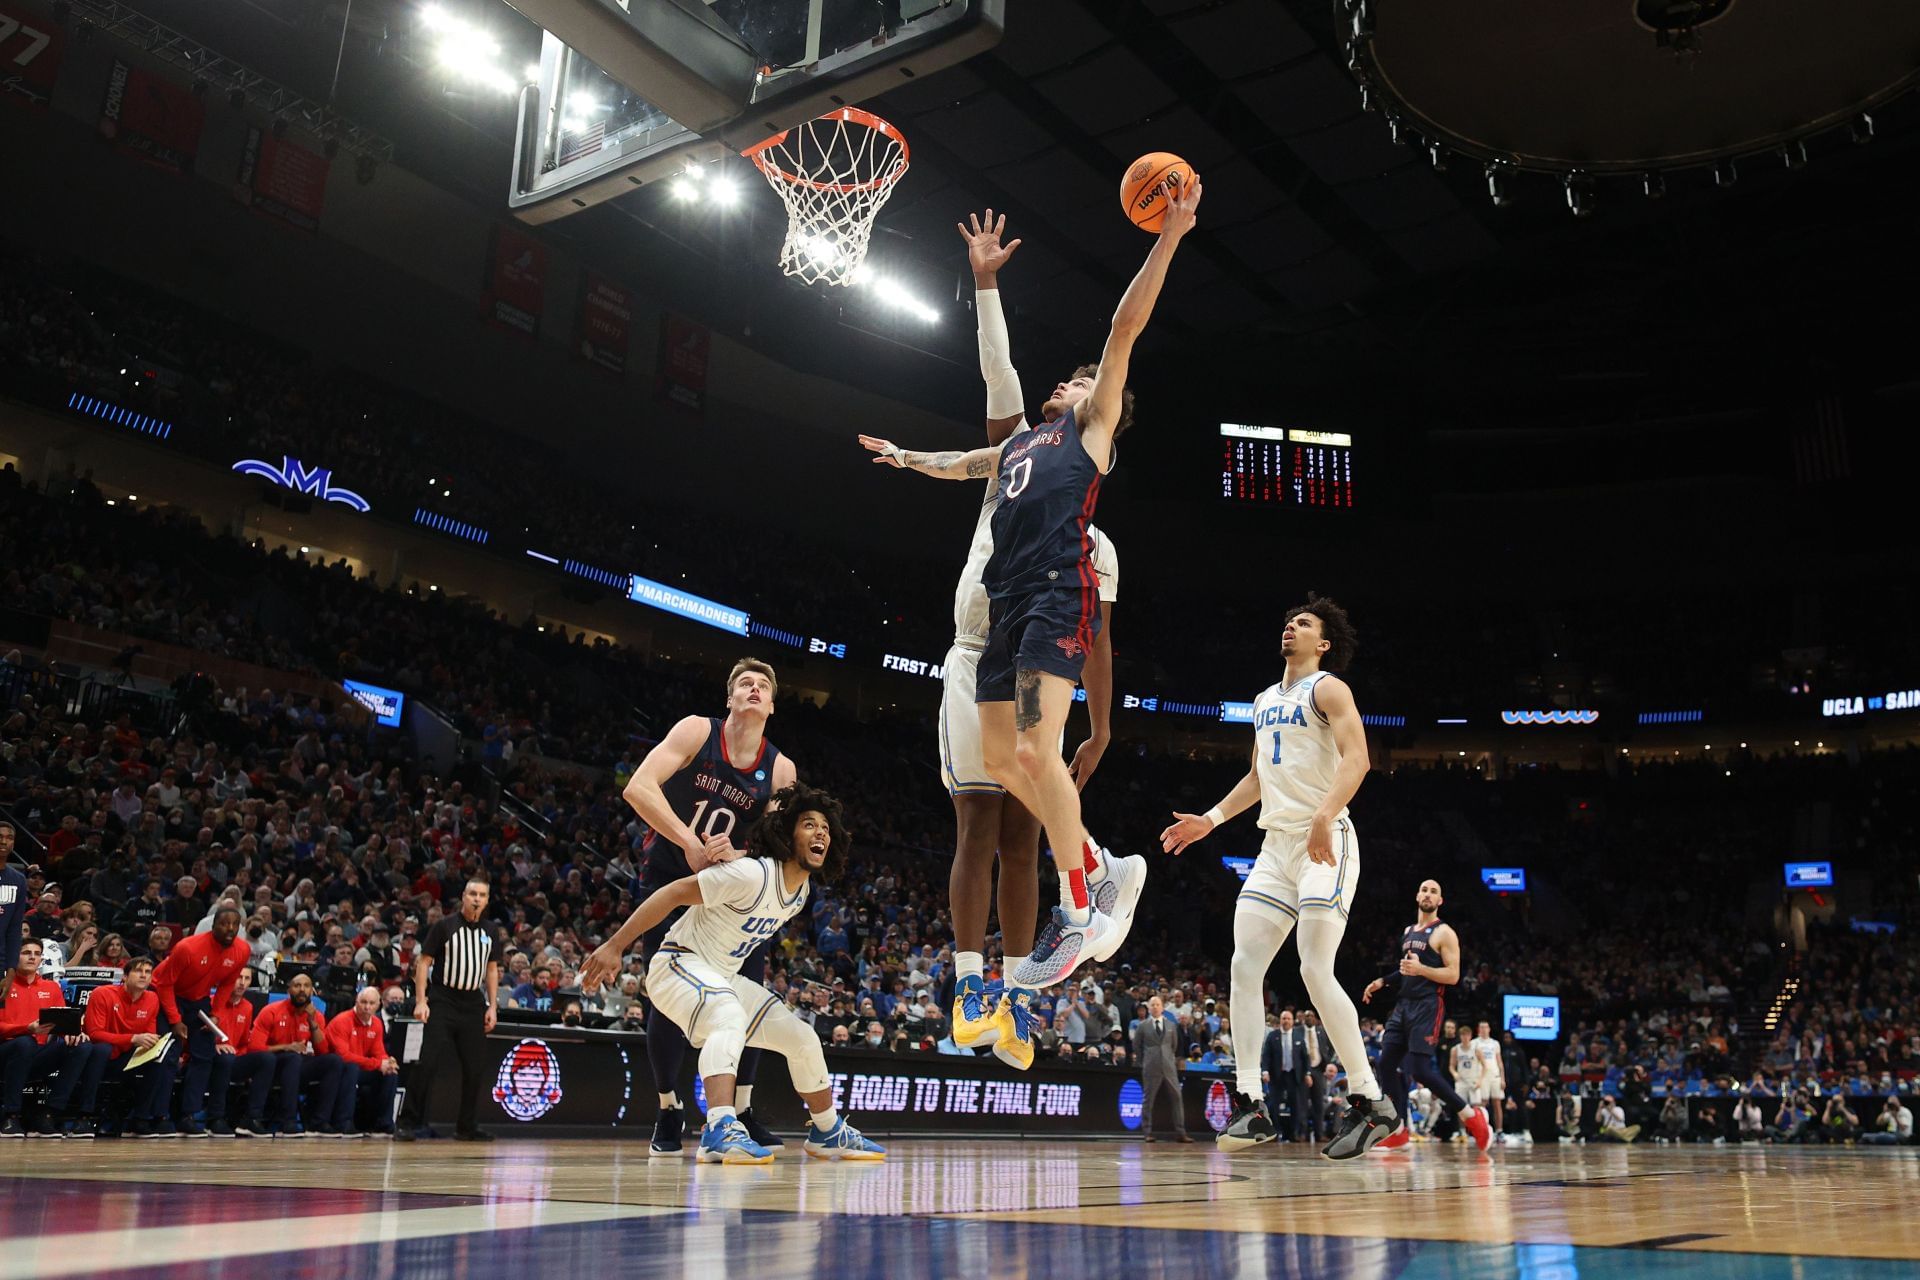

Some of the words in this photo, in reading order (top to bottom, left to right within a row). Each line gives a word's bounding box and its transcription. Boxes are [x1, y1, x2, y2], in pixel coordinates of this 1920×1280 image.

[1006, 457, 1034, 499] 0
[636, 582, 743, 629] #MARCHMADNESS
[883, 654, 929, 677] FIRST
[1256, 705, 1308, 732] UCLA
[1822, 696, 1865, 717] UCLA
[1271, 730, 1282, 765] 1
[695, 773, 722, 794] SAINT
[722, 783, 754, 810] MARY'S
[687, 799, 737, 838] 10
[848, 1074, 910, 1111] ROAD
[914, 1077, 941, 1112] TO
[944, 1079, 981, 1113] THE
[982, 1080, 1032, 1115] FINAL
[1035, 1083, 1081, 1116] FOUR
